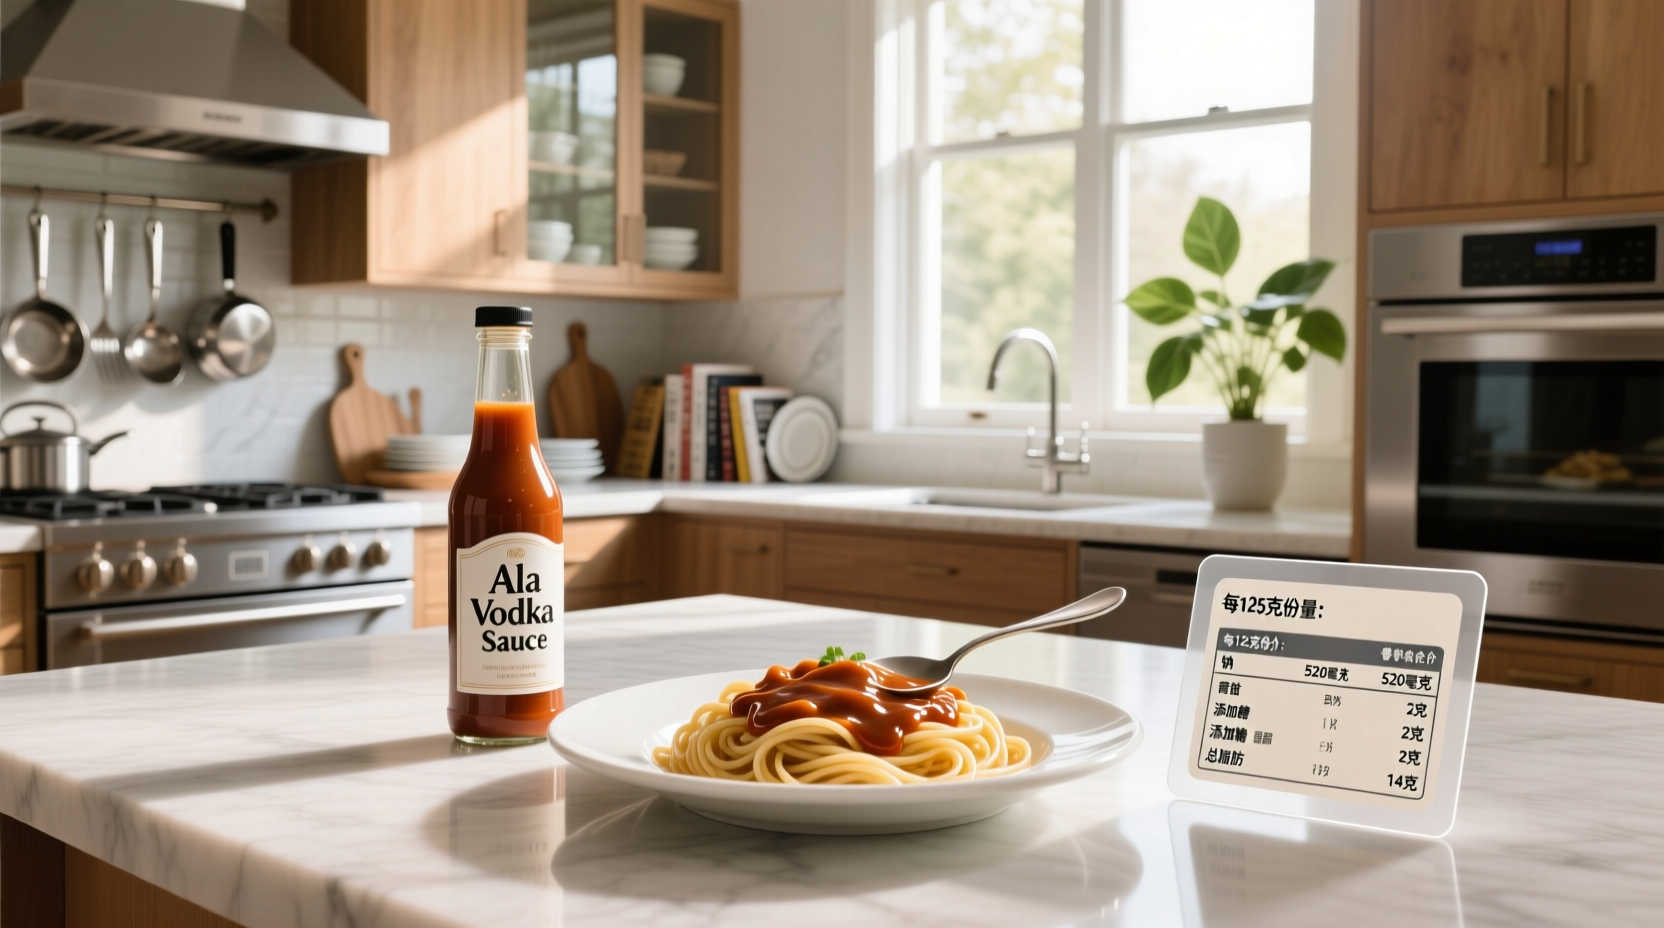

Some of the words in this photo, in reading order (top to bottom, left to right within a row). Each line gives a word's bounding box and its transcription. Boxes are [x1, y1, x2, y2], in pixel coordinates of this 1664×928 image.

[488, 563, 541, 594] Ala
[470, 597, 554, 626] Vodka
[1222, 592, 1324, 619] 每125克份量:
[482, 630, 547, 652] Sauce
[1401, 725, 1424, 742] 2克
[1398, 750, 1421, 766] 2克
[1387, 773, 1418, 791] 14克
